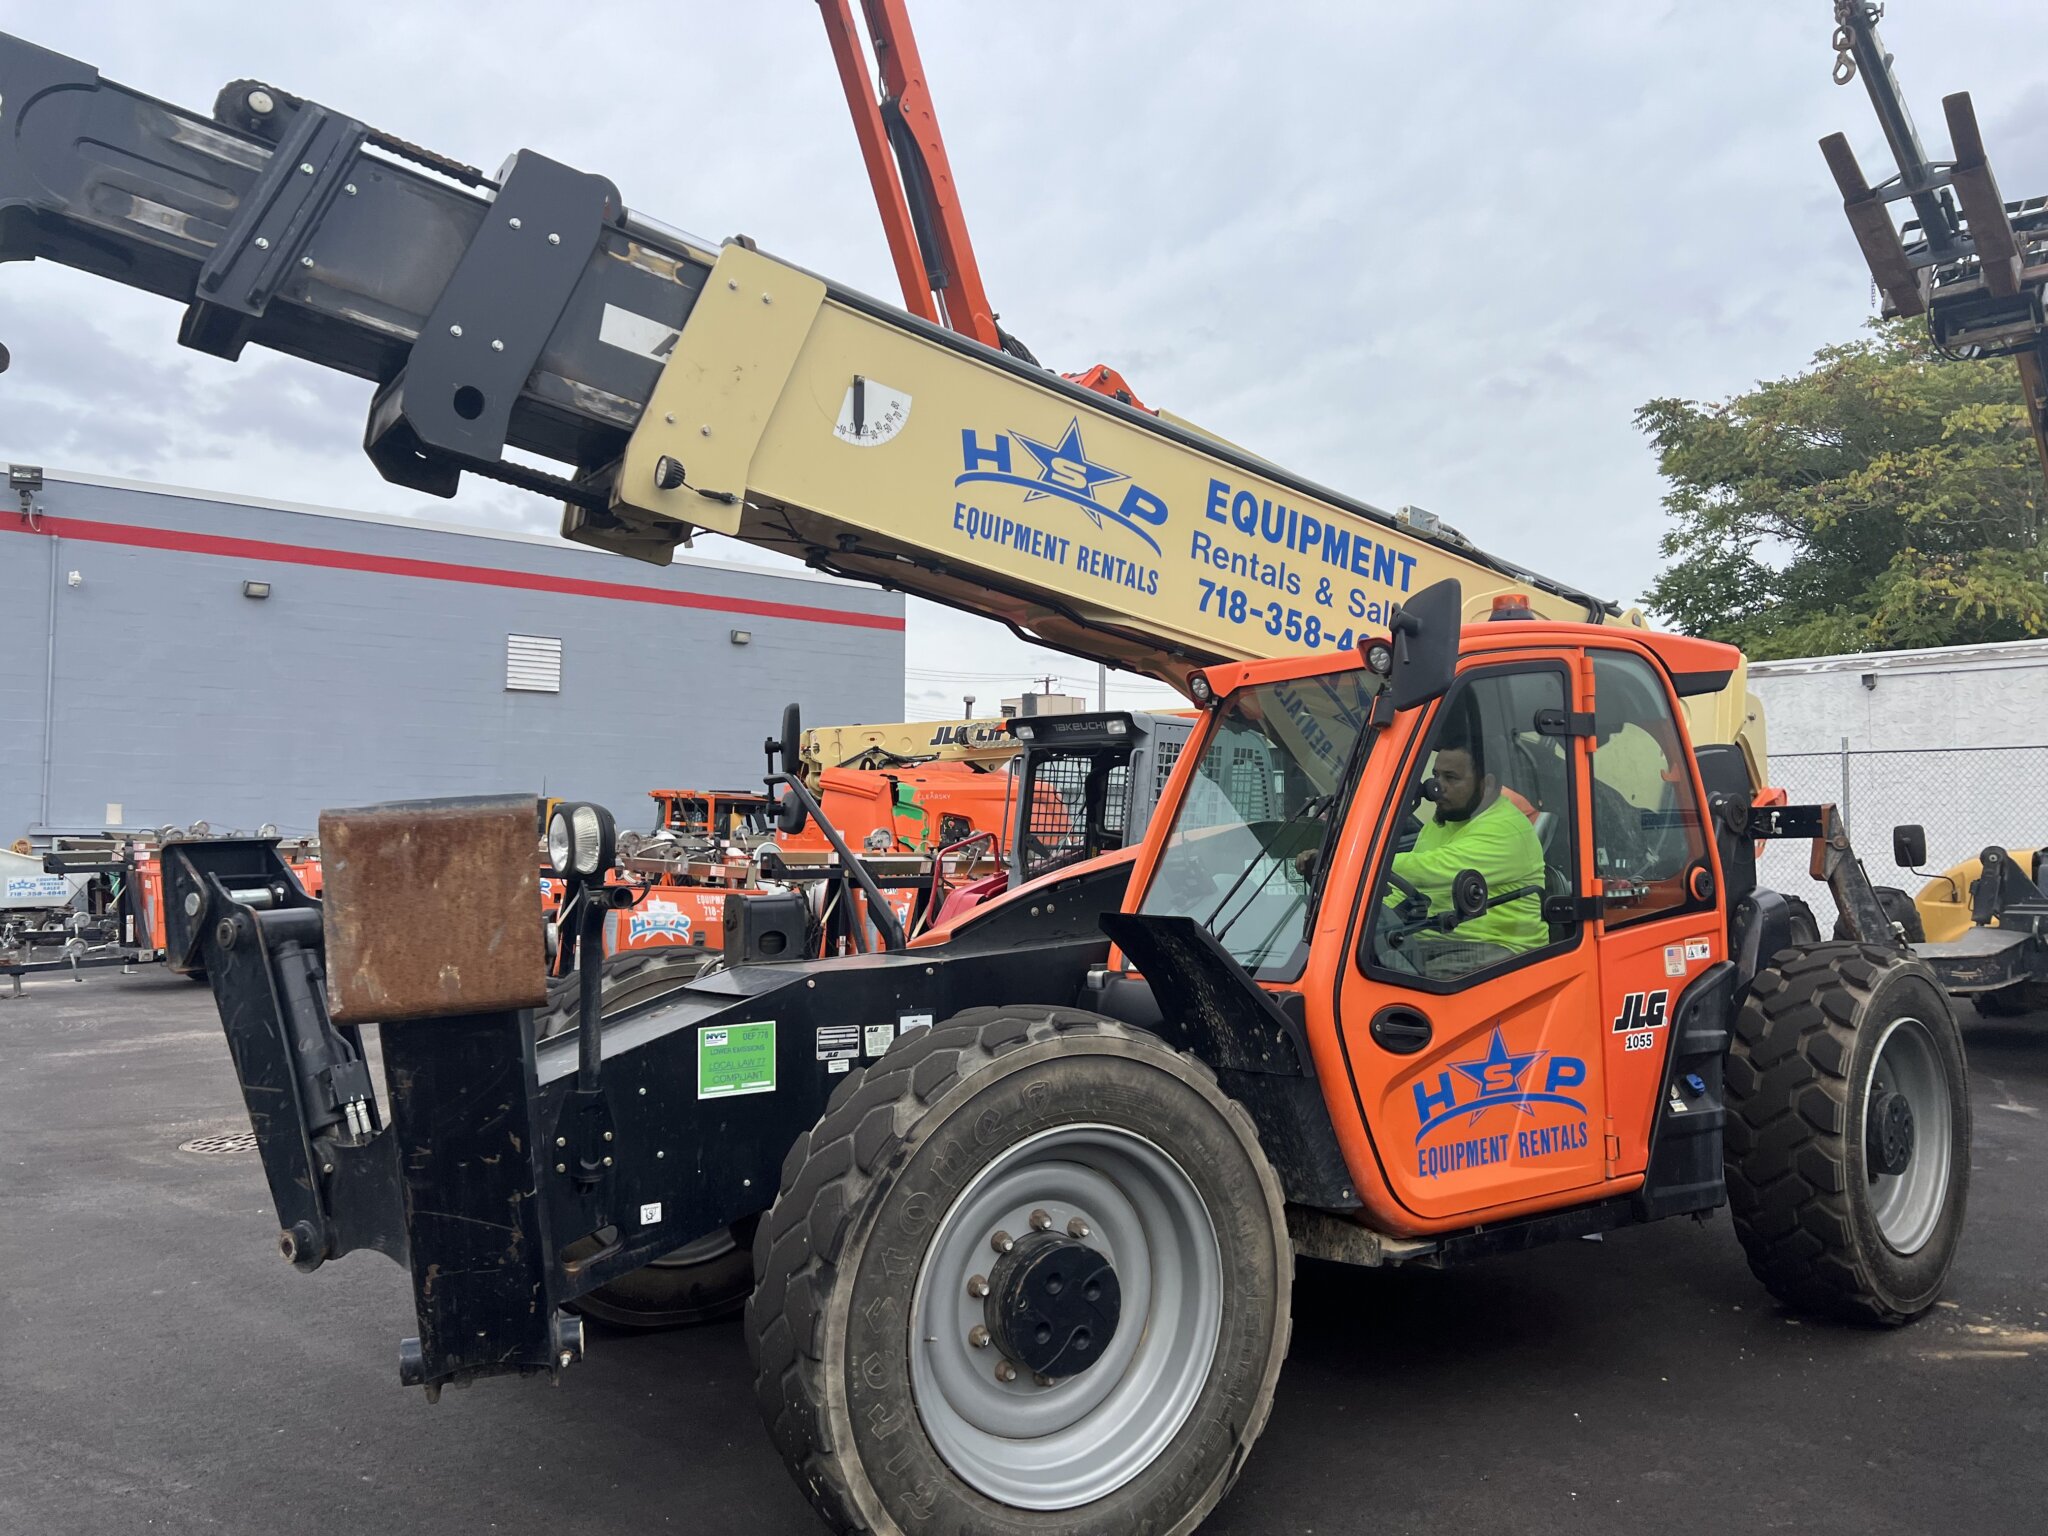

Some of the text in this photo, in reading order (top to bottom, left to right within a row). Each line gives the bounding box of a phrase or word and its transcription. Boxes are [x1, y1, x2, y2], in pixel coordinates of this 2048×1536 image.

[893, 411, 902, 420] 70
[1205, 477, 1418, 593] EQUIPMENT
[953, 501, 1160, 596] EQUIPMENT RENTALS
[1190, 529, 1391, 628] Rentals & Sal
[1198, 577, 1371, 652] 718-358-4
[696, 893, 726, 905] EQUIPME
[1613, 990, 1668, 1032] JLG
[706, 1032, 727, 1040] NYC
[1626, 1033, 1653, 1050] 1055
[710, 1044, 766, 1056] LOWER EMISSIONS
[709, 1060, 735, 1072] LOCAL
[738, 1058, 755, 1068] LAW
[712, 1071, 764, 1084] COMPLIANT
[1418, 1121, 1588, 1179] EQUIPMENT RENTALS
